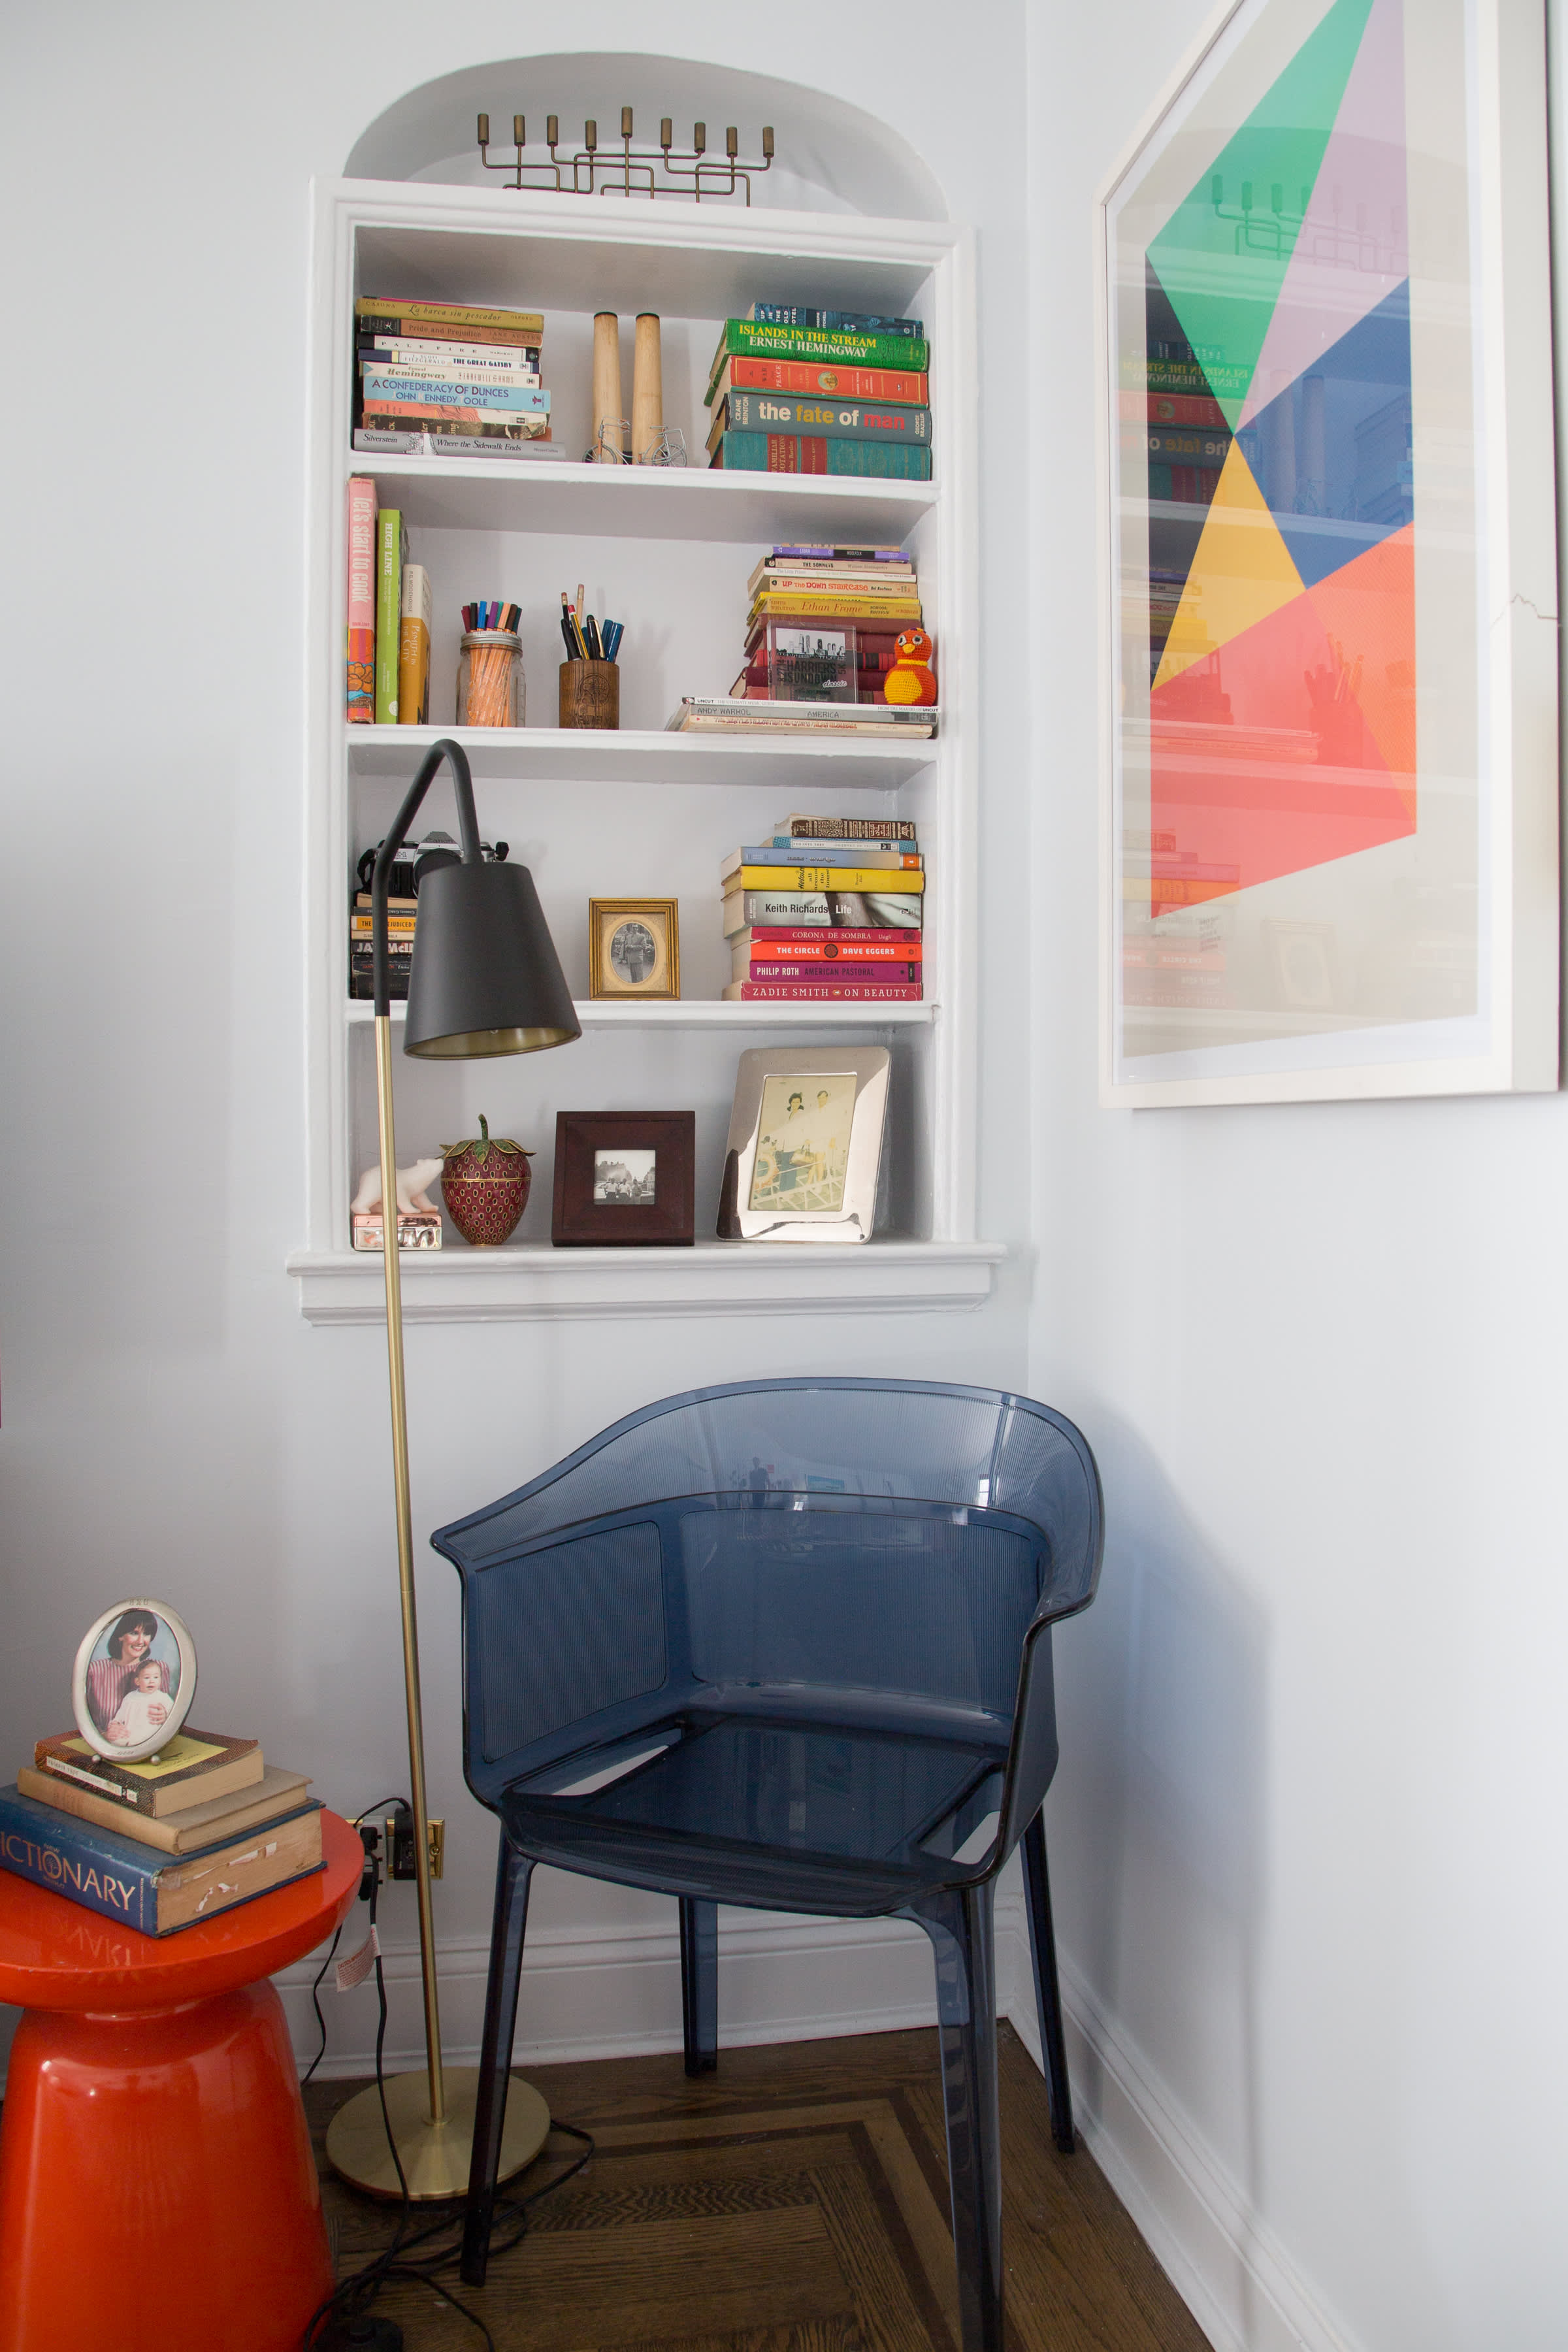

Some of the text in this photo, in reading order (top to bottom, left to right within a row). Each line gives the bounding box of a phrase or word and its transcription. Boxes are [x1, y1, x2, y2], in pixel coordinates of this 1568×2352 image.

[408, 304, 421, 316] La
[423, 306, 446, 315] barca
[760, 308, 765, 319] UP
[448, 328, 482, 338] Prejudice
[740, 324, 876, 348] ISLANDS IN THE STREAM
[749, 336, 868, 357] ERNEST HEMINGWAY
[387, 368, 446, 380] Hemingway
[372, 379, 509, 397] A CONFEDERACY OF DUNCES
[393, 391, 488, 406] JOHN KENNEDY TOOLE
[759, 402, 905, 430] the fate of man
[363, 434, 398, 443] Silverstein
[436, 438, 458, 448] Where
[472, 440, 503, 451] Sidewalk
[352, 497, 372, 522] let's
[352, 525, 372, 554] start
[352, 558, 371, 569] to
[351, 573, 371, 602] cook
[802, 601, 862, 612] Ethan Frome
[787, 659, 837, 674] HARRIERS
[838, 660, 847, 675] 5K
[787, 672, 838, 684] SUNDOWN
[823, 678, 847, 688] classic
[765, 904, 828, 913] Keith Richards
[836, 905, 852, 914] Life
[757, 967, 874, 976] PHILIP ROTH AMERICAN PASTORAL
[0, 1831, 136, 1911] ICTIONARY
